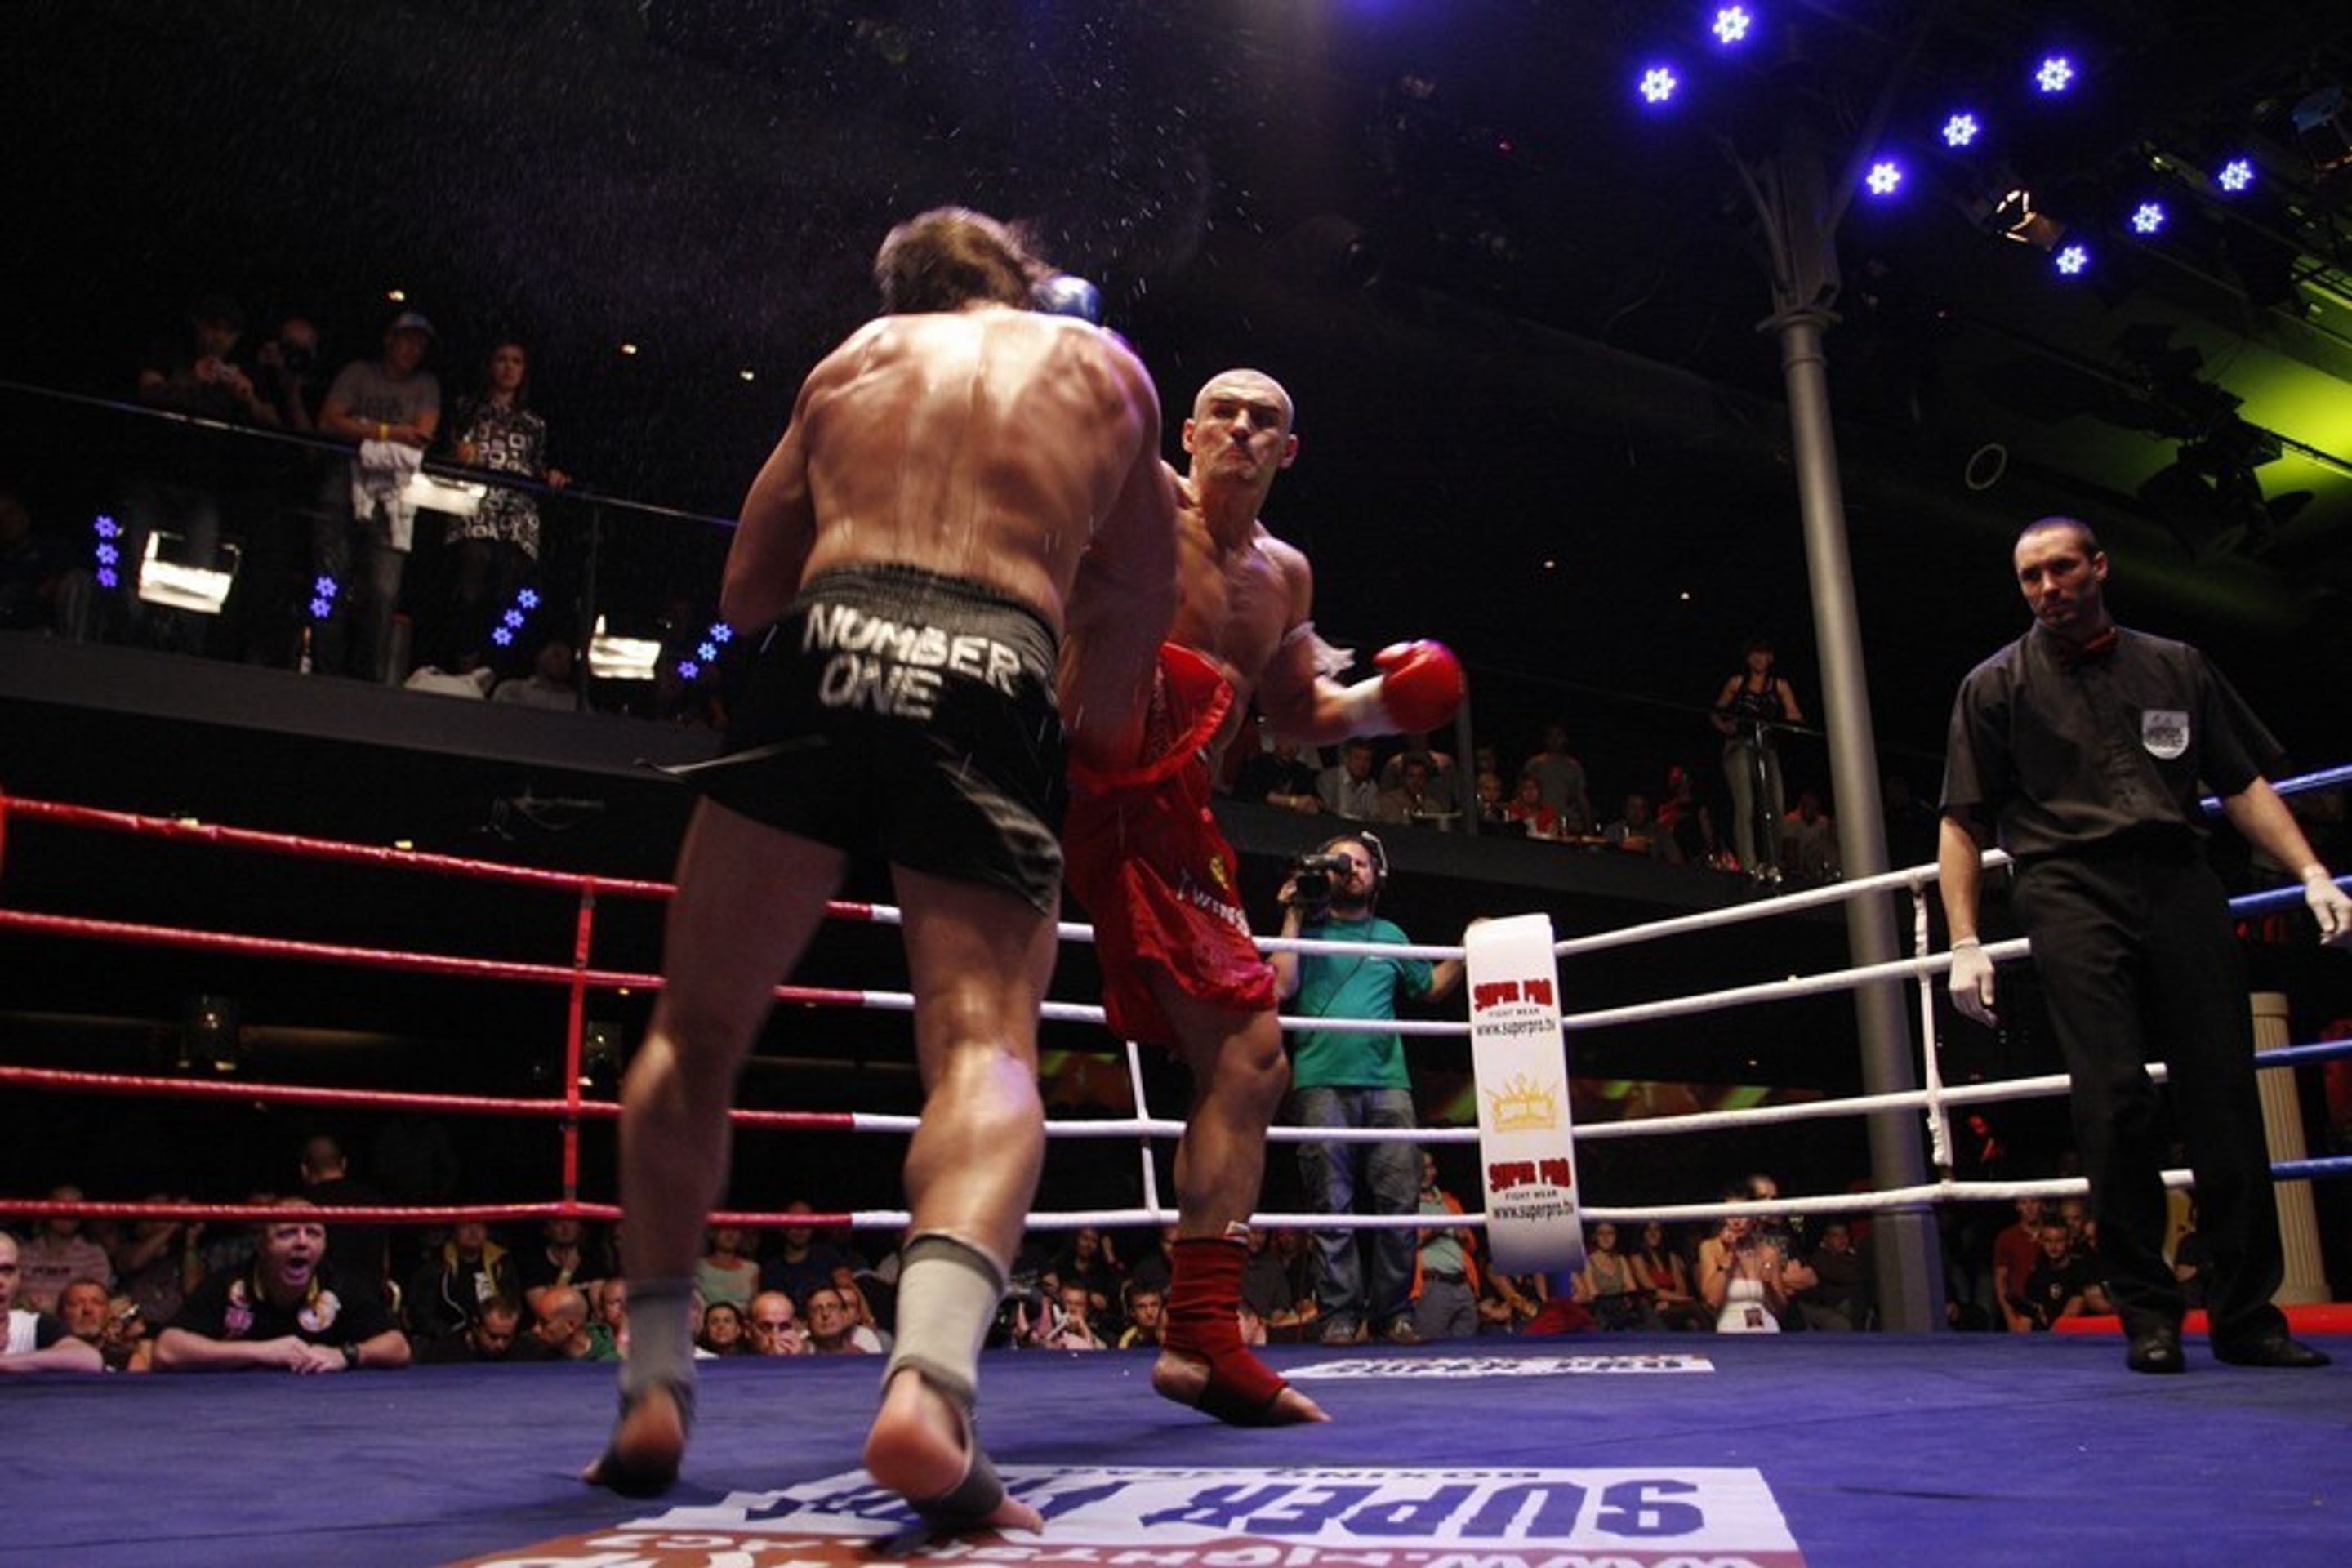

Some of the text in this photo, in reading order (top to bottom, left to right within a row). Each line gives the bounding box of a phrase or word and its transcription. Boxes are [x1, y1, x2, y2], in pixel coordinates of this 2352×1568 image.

[803, 604, 1021, 697] NUMBER
[818, 653, 942, 719] ONE
[1473, 978, 1553, 1013] SUPER PRO
[1489, 1157, 1571, 1193] SUPER PRO
[1139, 1479, 1705, 1539] SUPER
